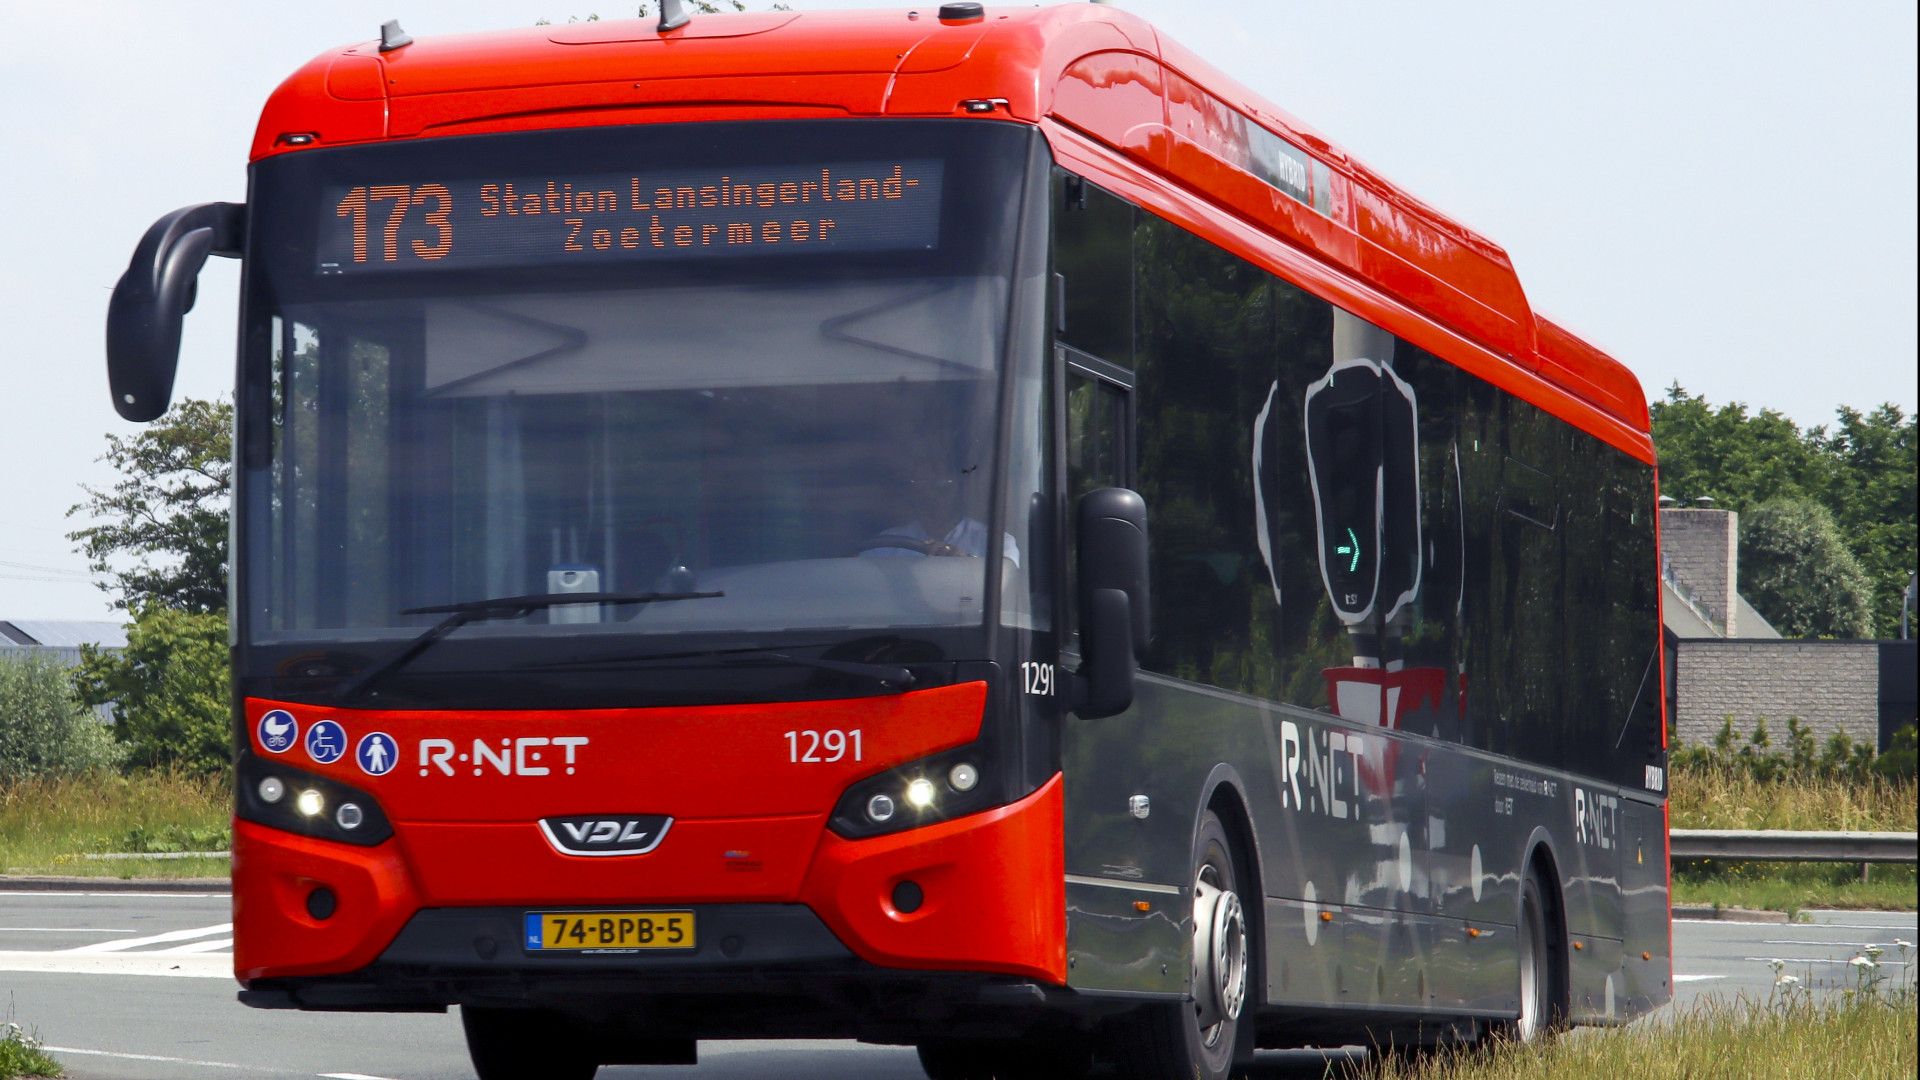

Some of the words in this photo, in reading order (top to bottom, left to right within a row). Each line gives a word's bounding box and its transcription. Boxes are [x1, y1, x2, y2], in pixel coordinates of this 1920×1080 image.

[480, 183, 617, 217] Station
[631, 165, 920, 212] Lansingerland-
[337, 184, 453, 263] 173
[564, 214, 837, 252] Zoetermeer
[1021, 662, 1055, 696] 1291
[784, 729, 863, 763] 1291
[1645, 764, 1663, 792] HYBRID
[561, 821, 648, 843] VDL
[528, 935, 541, 944] NL
[552, 918, 684, 945] 74-BPB-5
